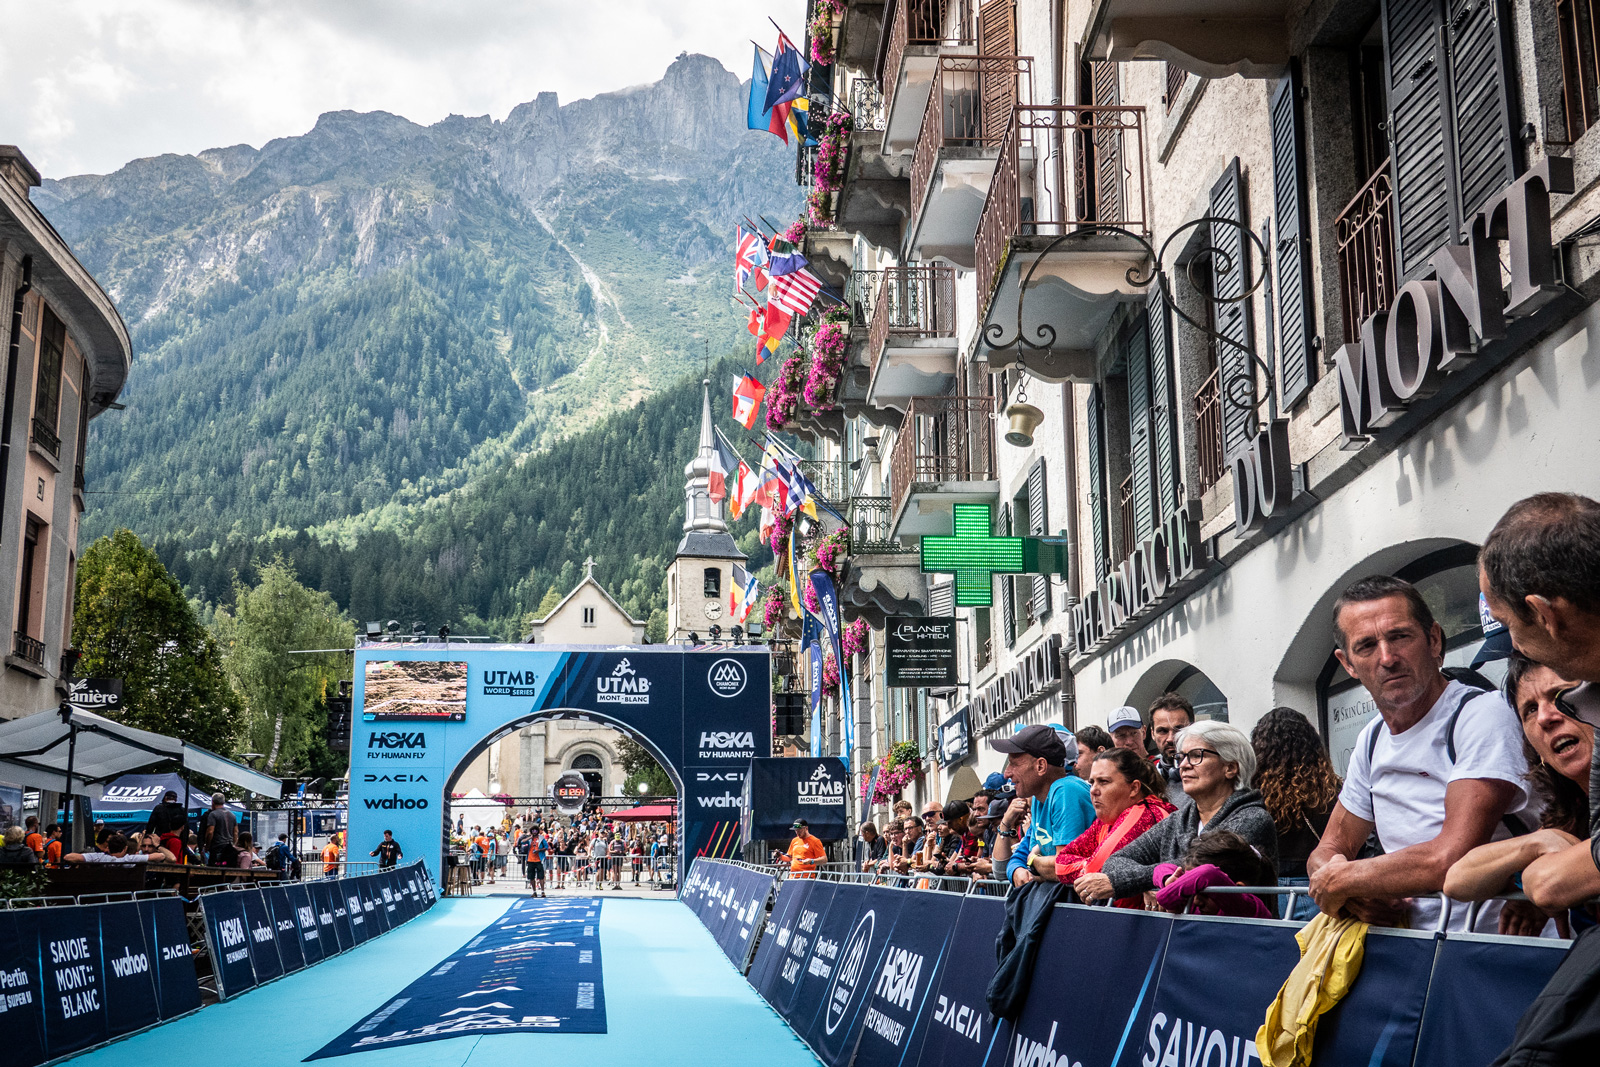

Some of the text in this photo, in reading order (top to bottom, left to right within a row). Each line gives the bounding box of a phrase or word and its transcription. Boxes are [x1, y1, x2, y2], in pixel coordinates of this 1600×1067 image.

[1072, 156, 1573, 658] PHARMACIE DU MONT
[903, 625, 949, 633] PLANET
[484, 670, 535, 685] UTMB
[597, 677, 650, 693] UTMB
[69, 689, 118, 704] anière
[368, 732, 426, 748] HOKA
[699, 732, 755, 748] HOKA
[364, 774, 428, 782] DACIA
[697, 773, 744, 781] DACI
[107, 785, 164, 796] UTMB
[798, 780, 844, 795] UTMB
[363, 793, 428, 809] wahoo
[219, 917, 245, 948] HOKA
[252, 920, 274, 943] wahoo
[277, 919, 295, 931] DACIA
[50, 937, 90, 964] SAVOIE
[162, 943, 192, 960] DACIA
[111, 946, 148, 978] wahoo
[0, 967, 29, 989] Pertin
[55, 965, 87, 992] MONT
[875, 945, 924, 1012] HOKA
[7, 992, 27, 1009] SUPER
[61, 988, 100, 1019] BLANC
[934, 994, 982, 1044] DACIA
